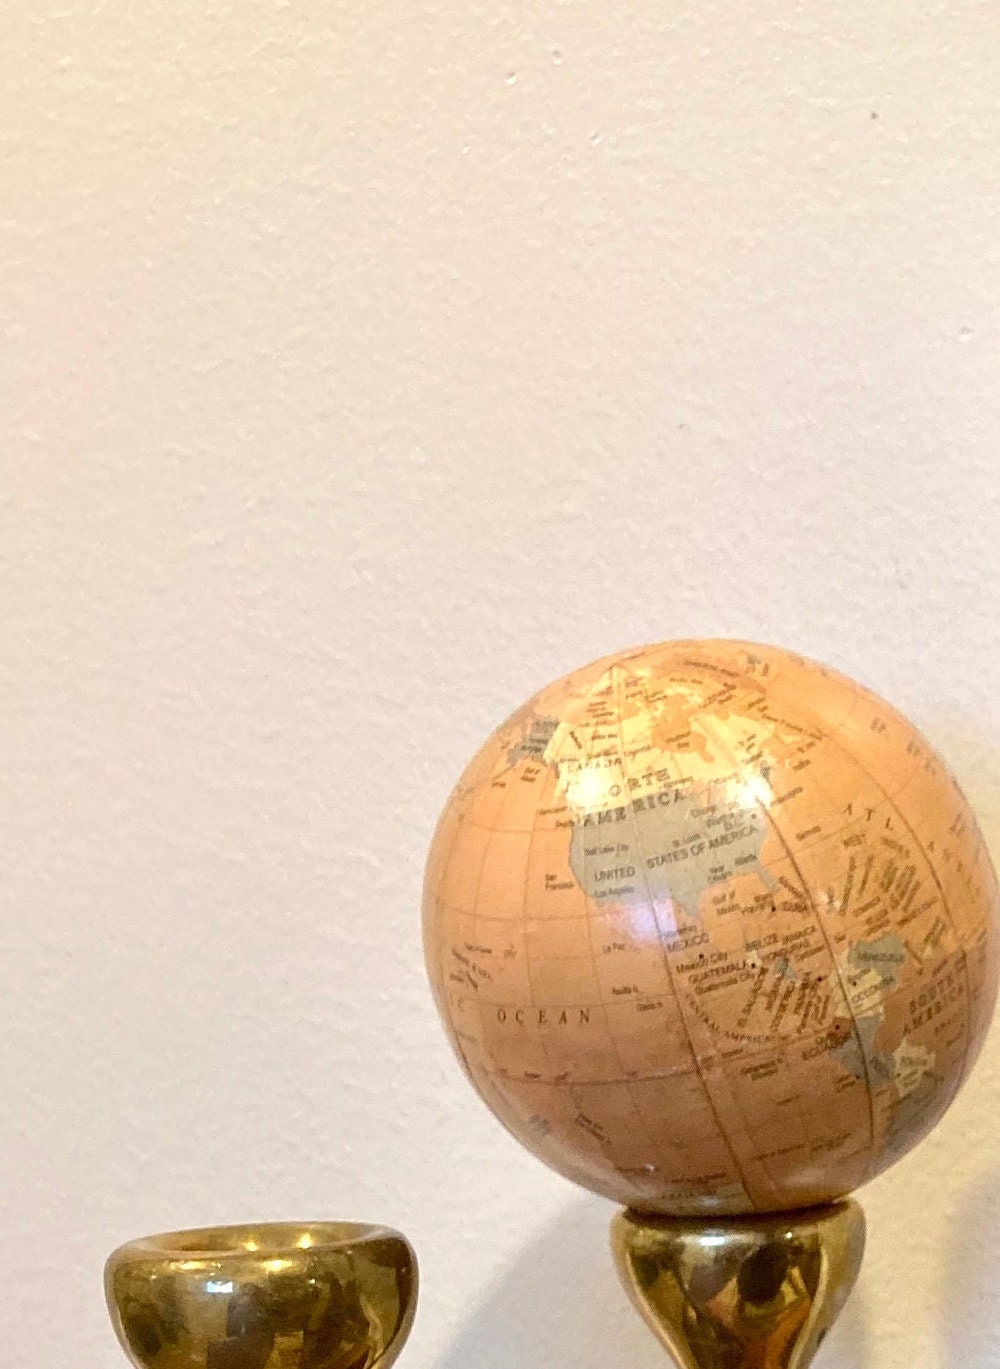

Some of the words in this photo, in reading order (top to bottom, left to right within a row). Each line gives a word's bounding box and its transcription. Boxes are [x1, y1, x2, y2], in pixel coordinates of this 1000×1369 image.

[583, 788, 687, 828] AMERICA
[594, 865, 636, 882] UNITED
[646, 849, 689, 869] STATES
[690, 841, 706, 857] OF
[709, 824, 760, 850] AMERICA
[496, 1008, 592, 1026] OCEAN
